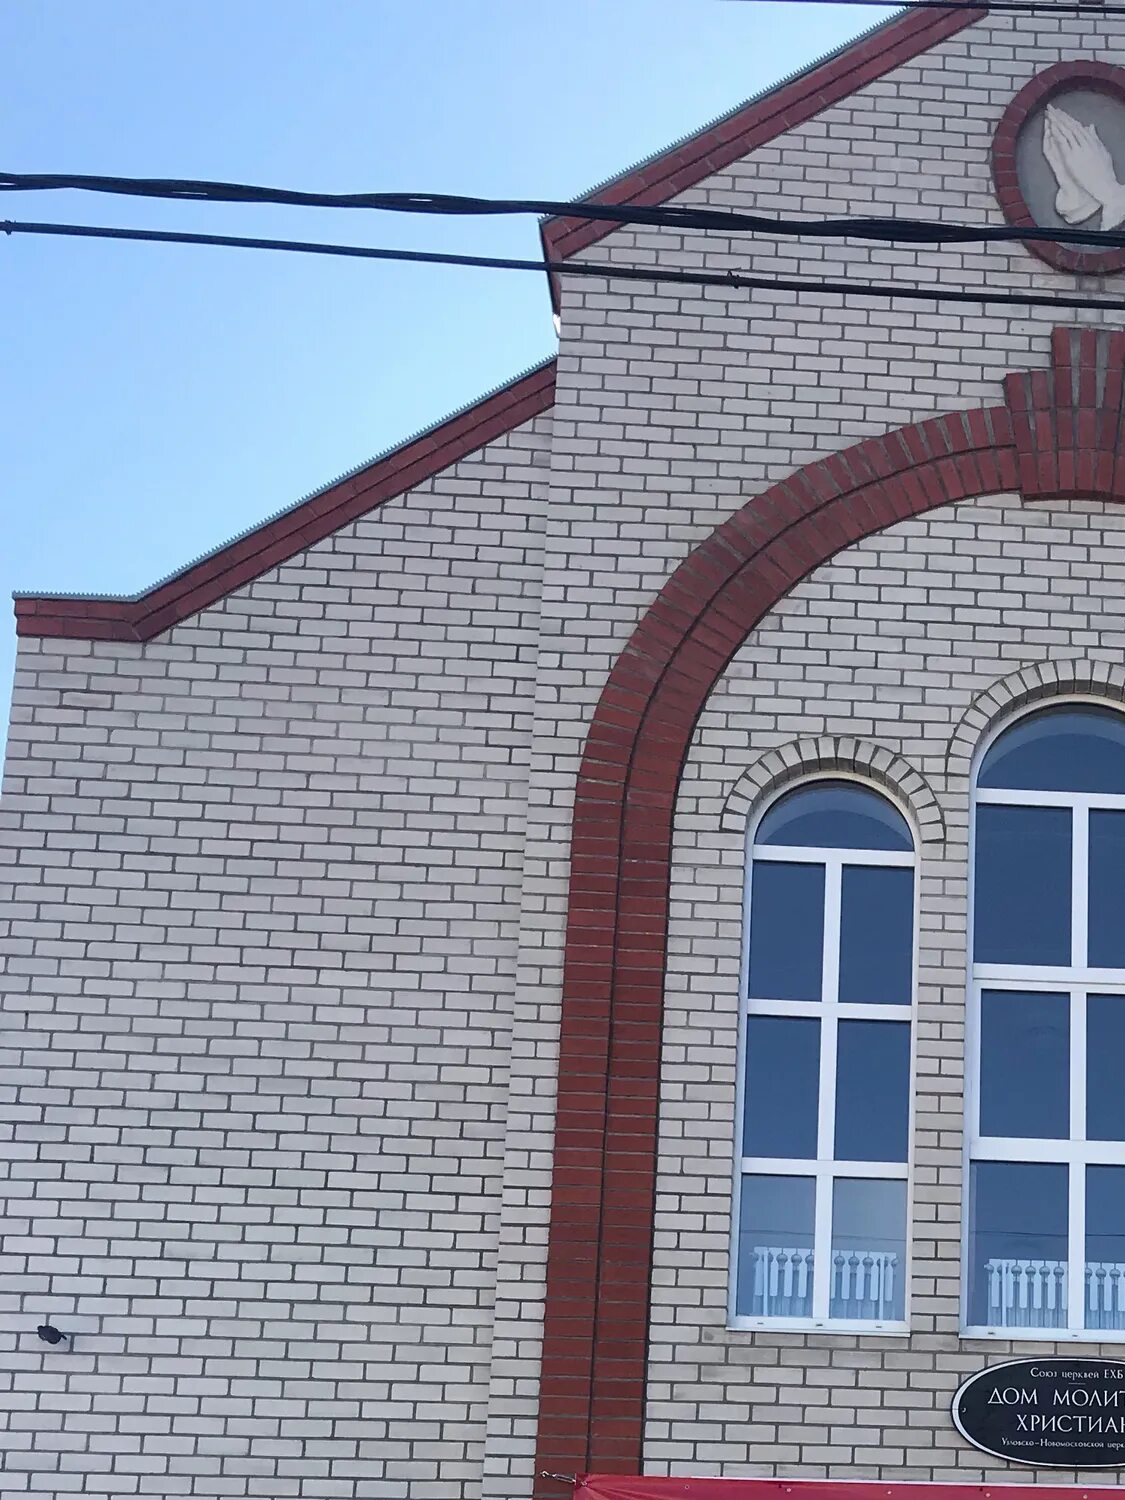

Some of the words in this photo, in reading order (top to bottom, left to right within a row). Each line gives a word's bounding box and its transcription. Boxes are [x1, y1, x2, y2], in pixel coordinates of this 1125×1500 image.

[1030, 1367, 1057, 1378] Союз
[1061, 1371, 1100, 1381] церквей
[1104, 1369, 1124, 1379] ЕХБ
[988, 1387, 1038, 1405] ДОМ
